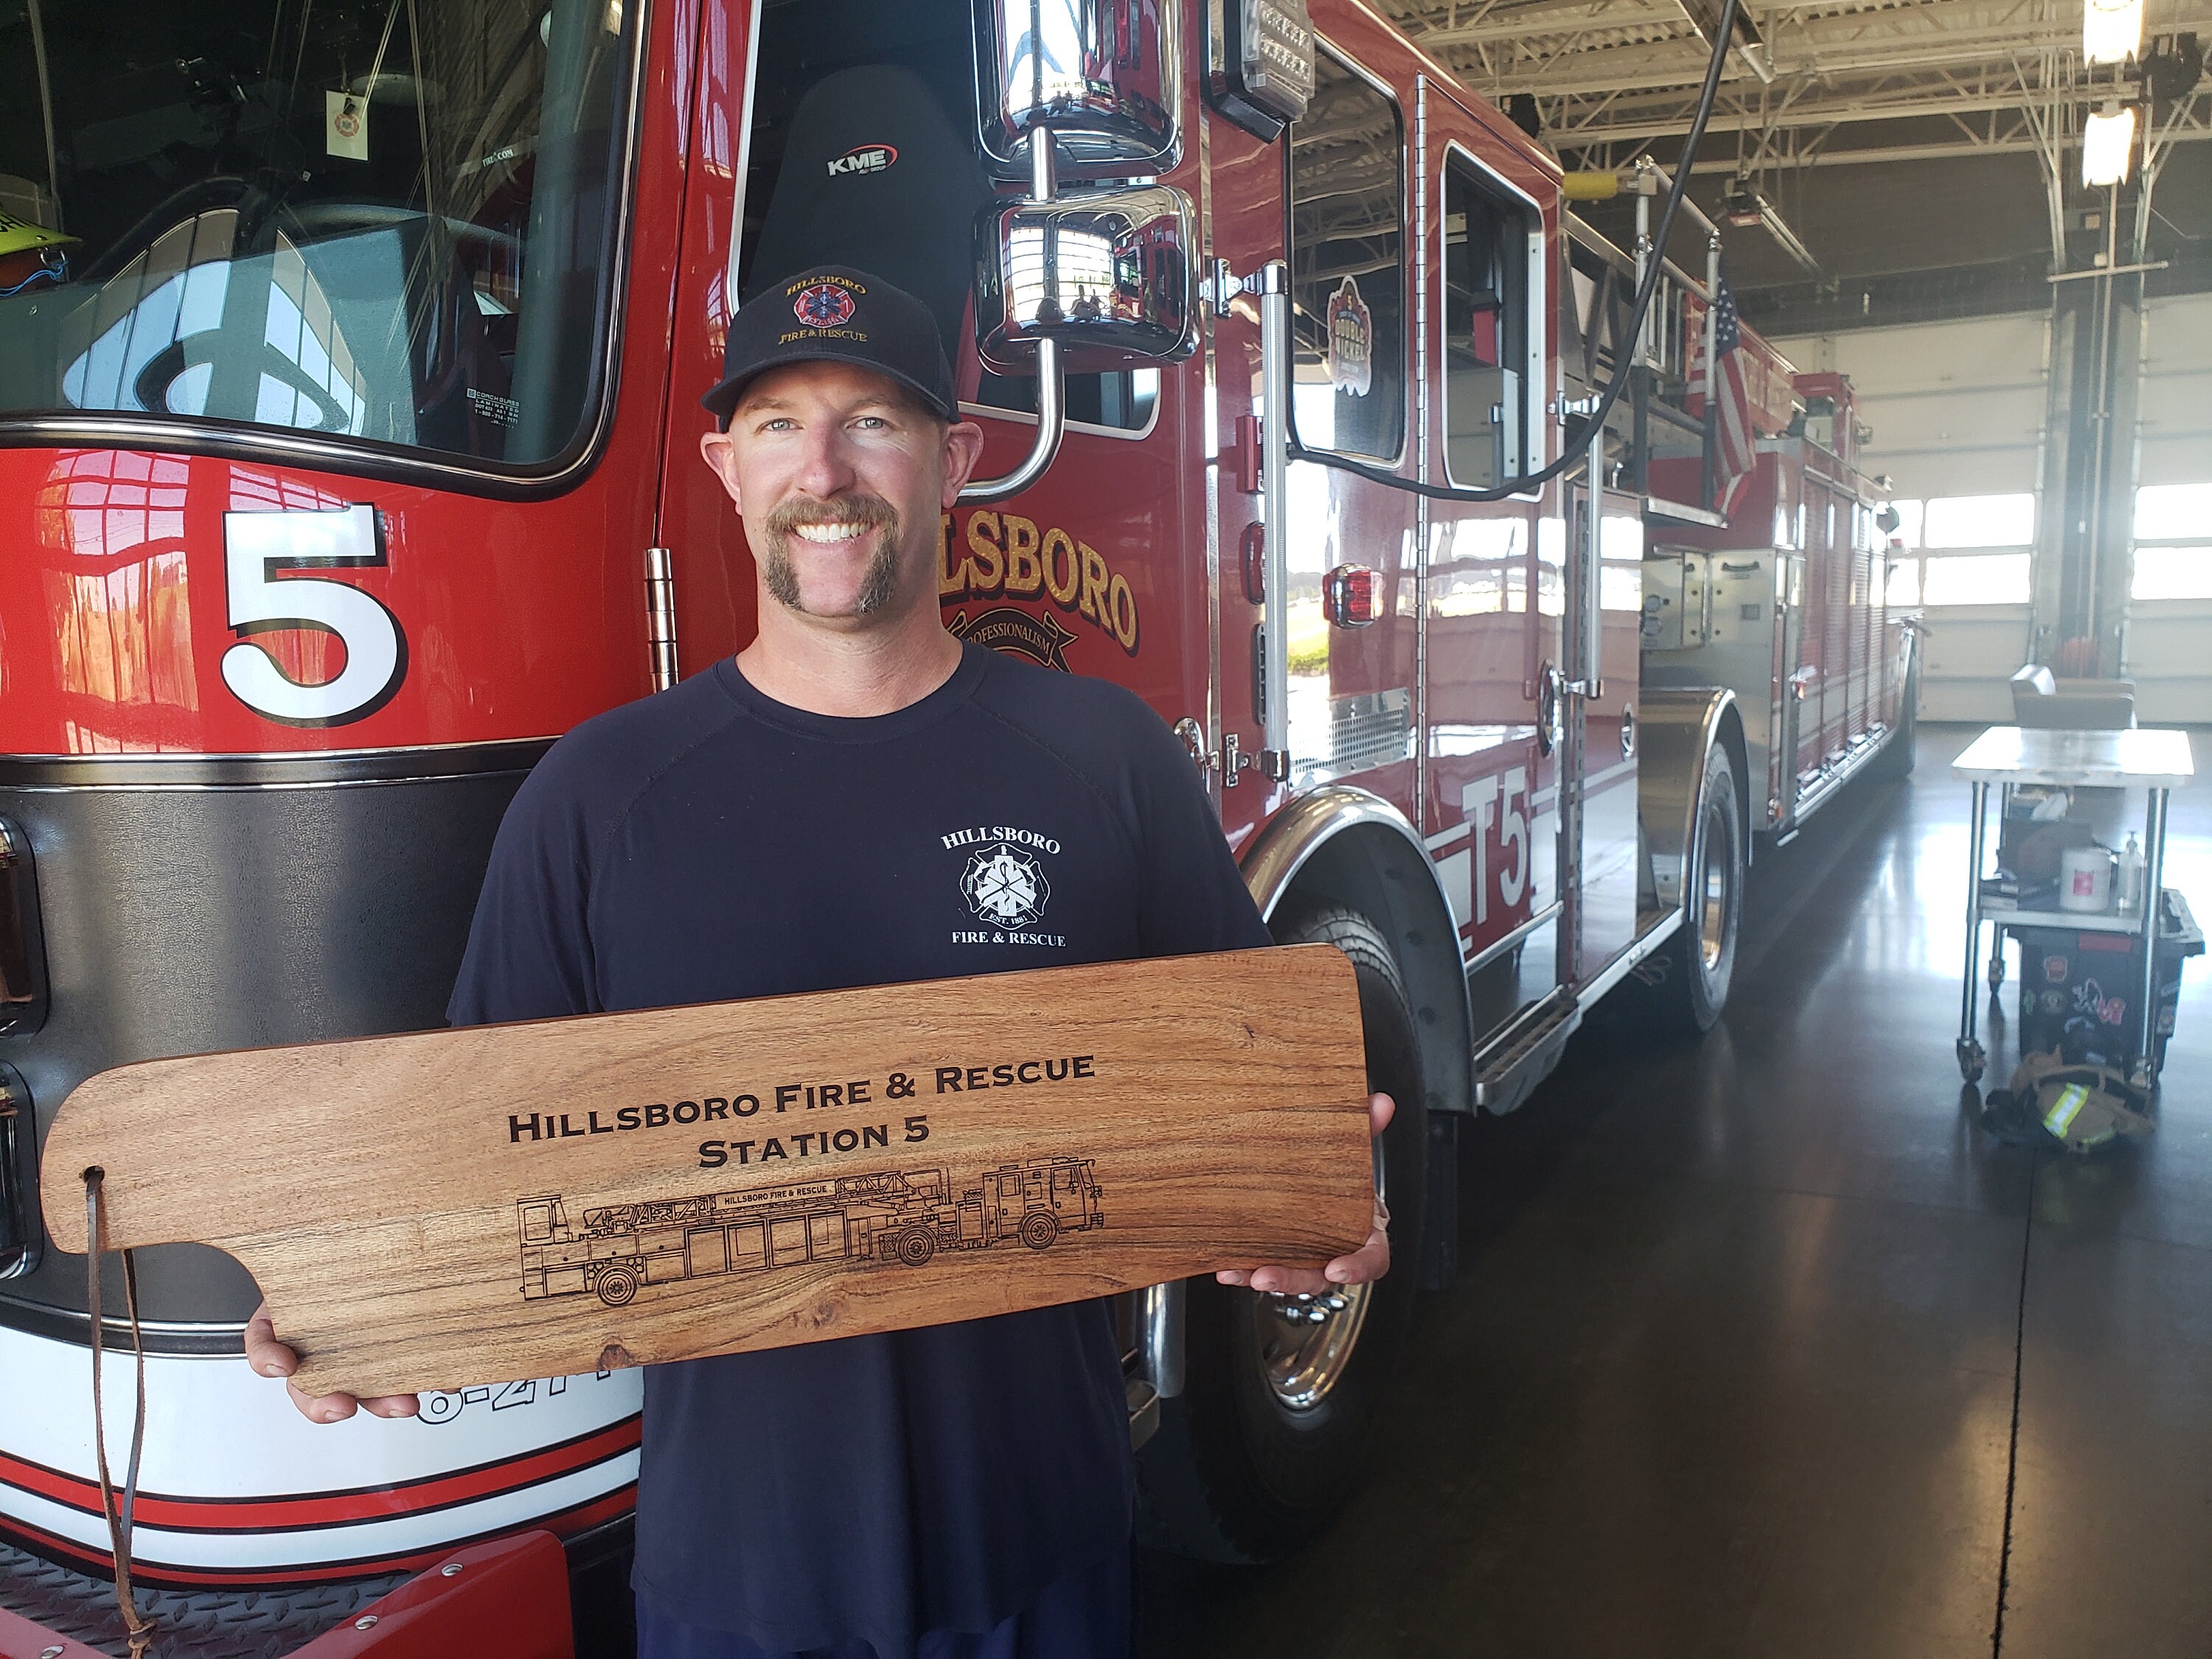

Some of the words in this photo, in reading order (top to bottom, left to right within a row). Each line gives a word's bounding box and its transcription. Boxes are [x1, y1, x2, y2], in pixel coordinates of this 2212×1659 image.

[827, 150, 886, 176] KME
[785, 276, 867, 297] HILLSBORO
[779, 330, 807, 345] FIRE
[808, 330, 816, 338] &
[819, 329, 867, 342] RESCUE
[476, 399, 519, 413] LAMINATED
[938, 509, 1139, 658] LSBORO
[220, 502, 409, 728] 5
[967, 622, 1050, 655] ROFESSIONALISM
[941, 826, 1061, 855] HILLSBORO
[1462, 765, 1527, 925] T5
[989, 913, 1009, 925] EST.
[1011, 914, 1029, 925] 1881
[952, 931, 989, 944] FIRE
[992, 932, 1005, 944] &
[1009, 932, 1066, 947] RESCUE
[508, 1094, 760, 1143] HILLSBORO
[774, 1079, 872, 1113] FIRE
[886, 1072, 916, 1099] &
[935, 1054, 1095, 1093] RESCUE
[699, 1124, 889, 1168] STATION
[903, 1114, 930, 1143] 5
[724, 1193, 768, 1205] HILLSBORO
[770, 1190, 787, 1200] FIRE
[796, 1186, 827, 1197] RESCUE
